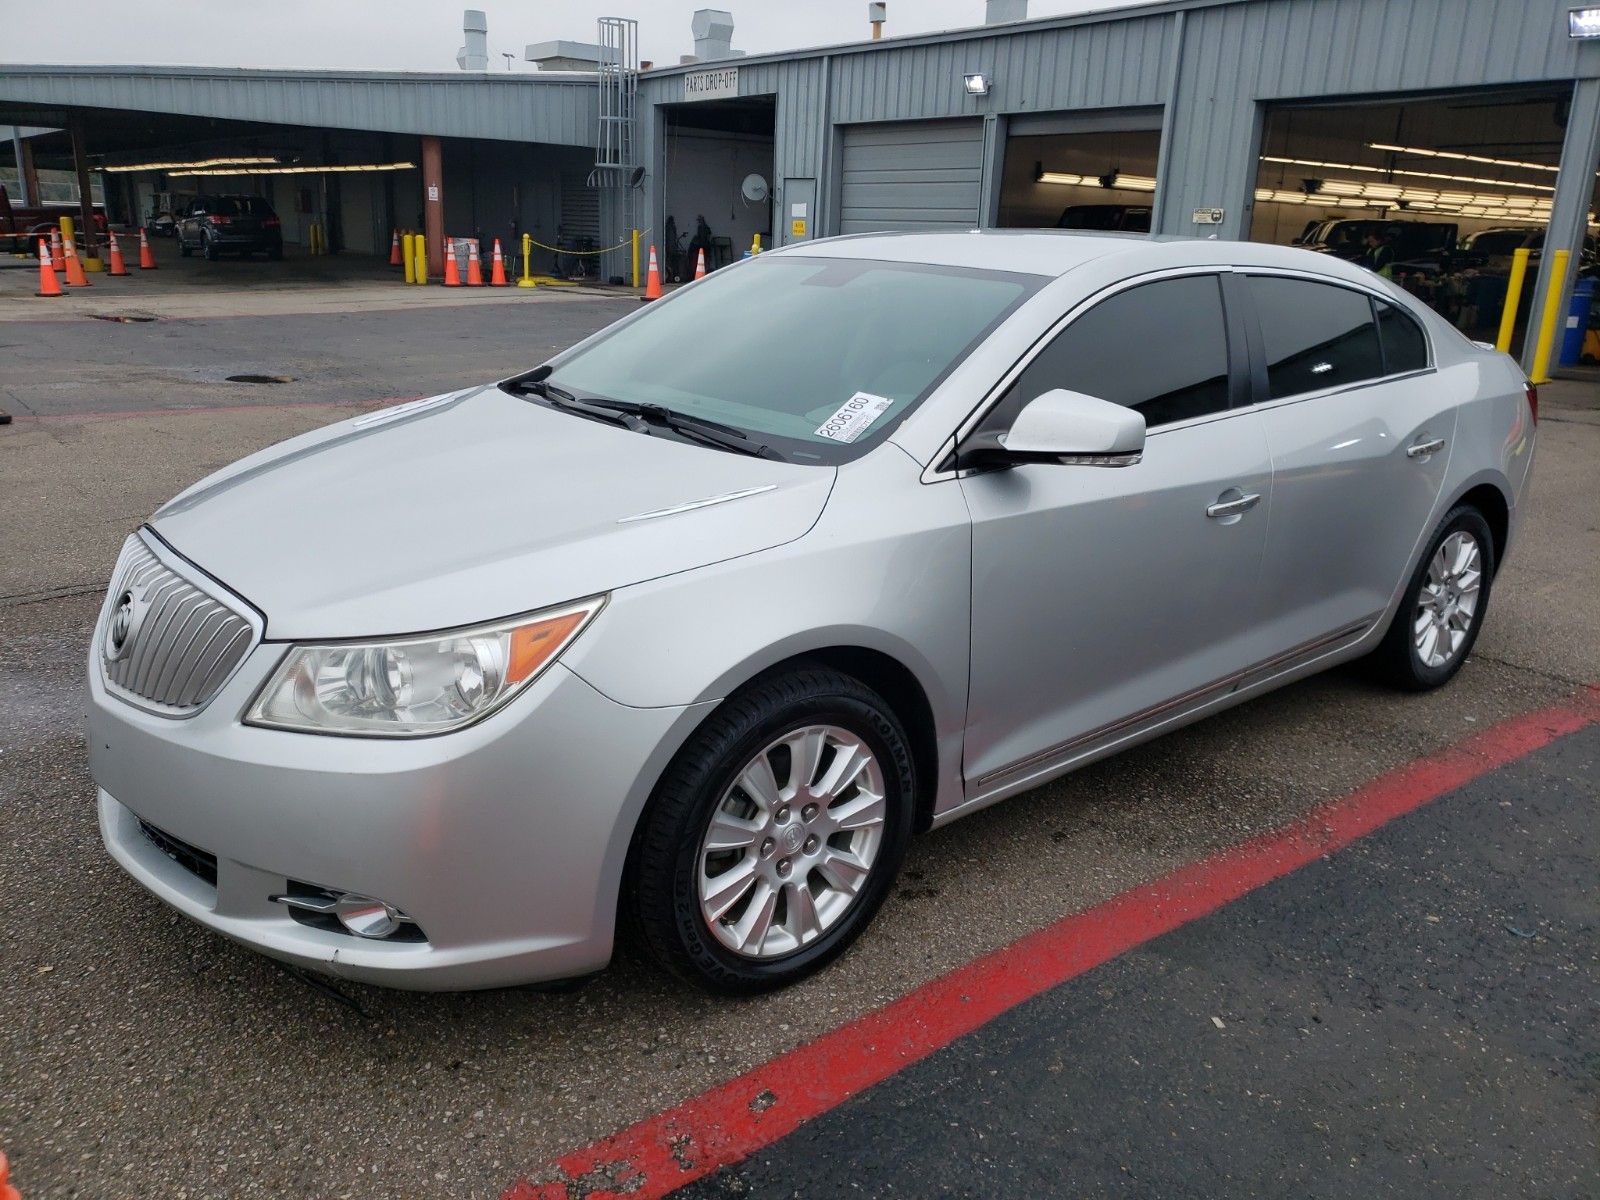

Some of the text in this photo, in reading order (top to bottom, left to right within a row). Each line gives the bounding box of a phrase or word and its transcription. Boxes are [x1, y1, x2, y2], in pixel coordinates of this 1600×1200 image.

[686, 71, 737, 93] PARTS DROP-OFF
[820, 397, 869, 437] 2606160
